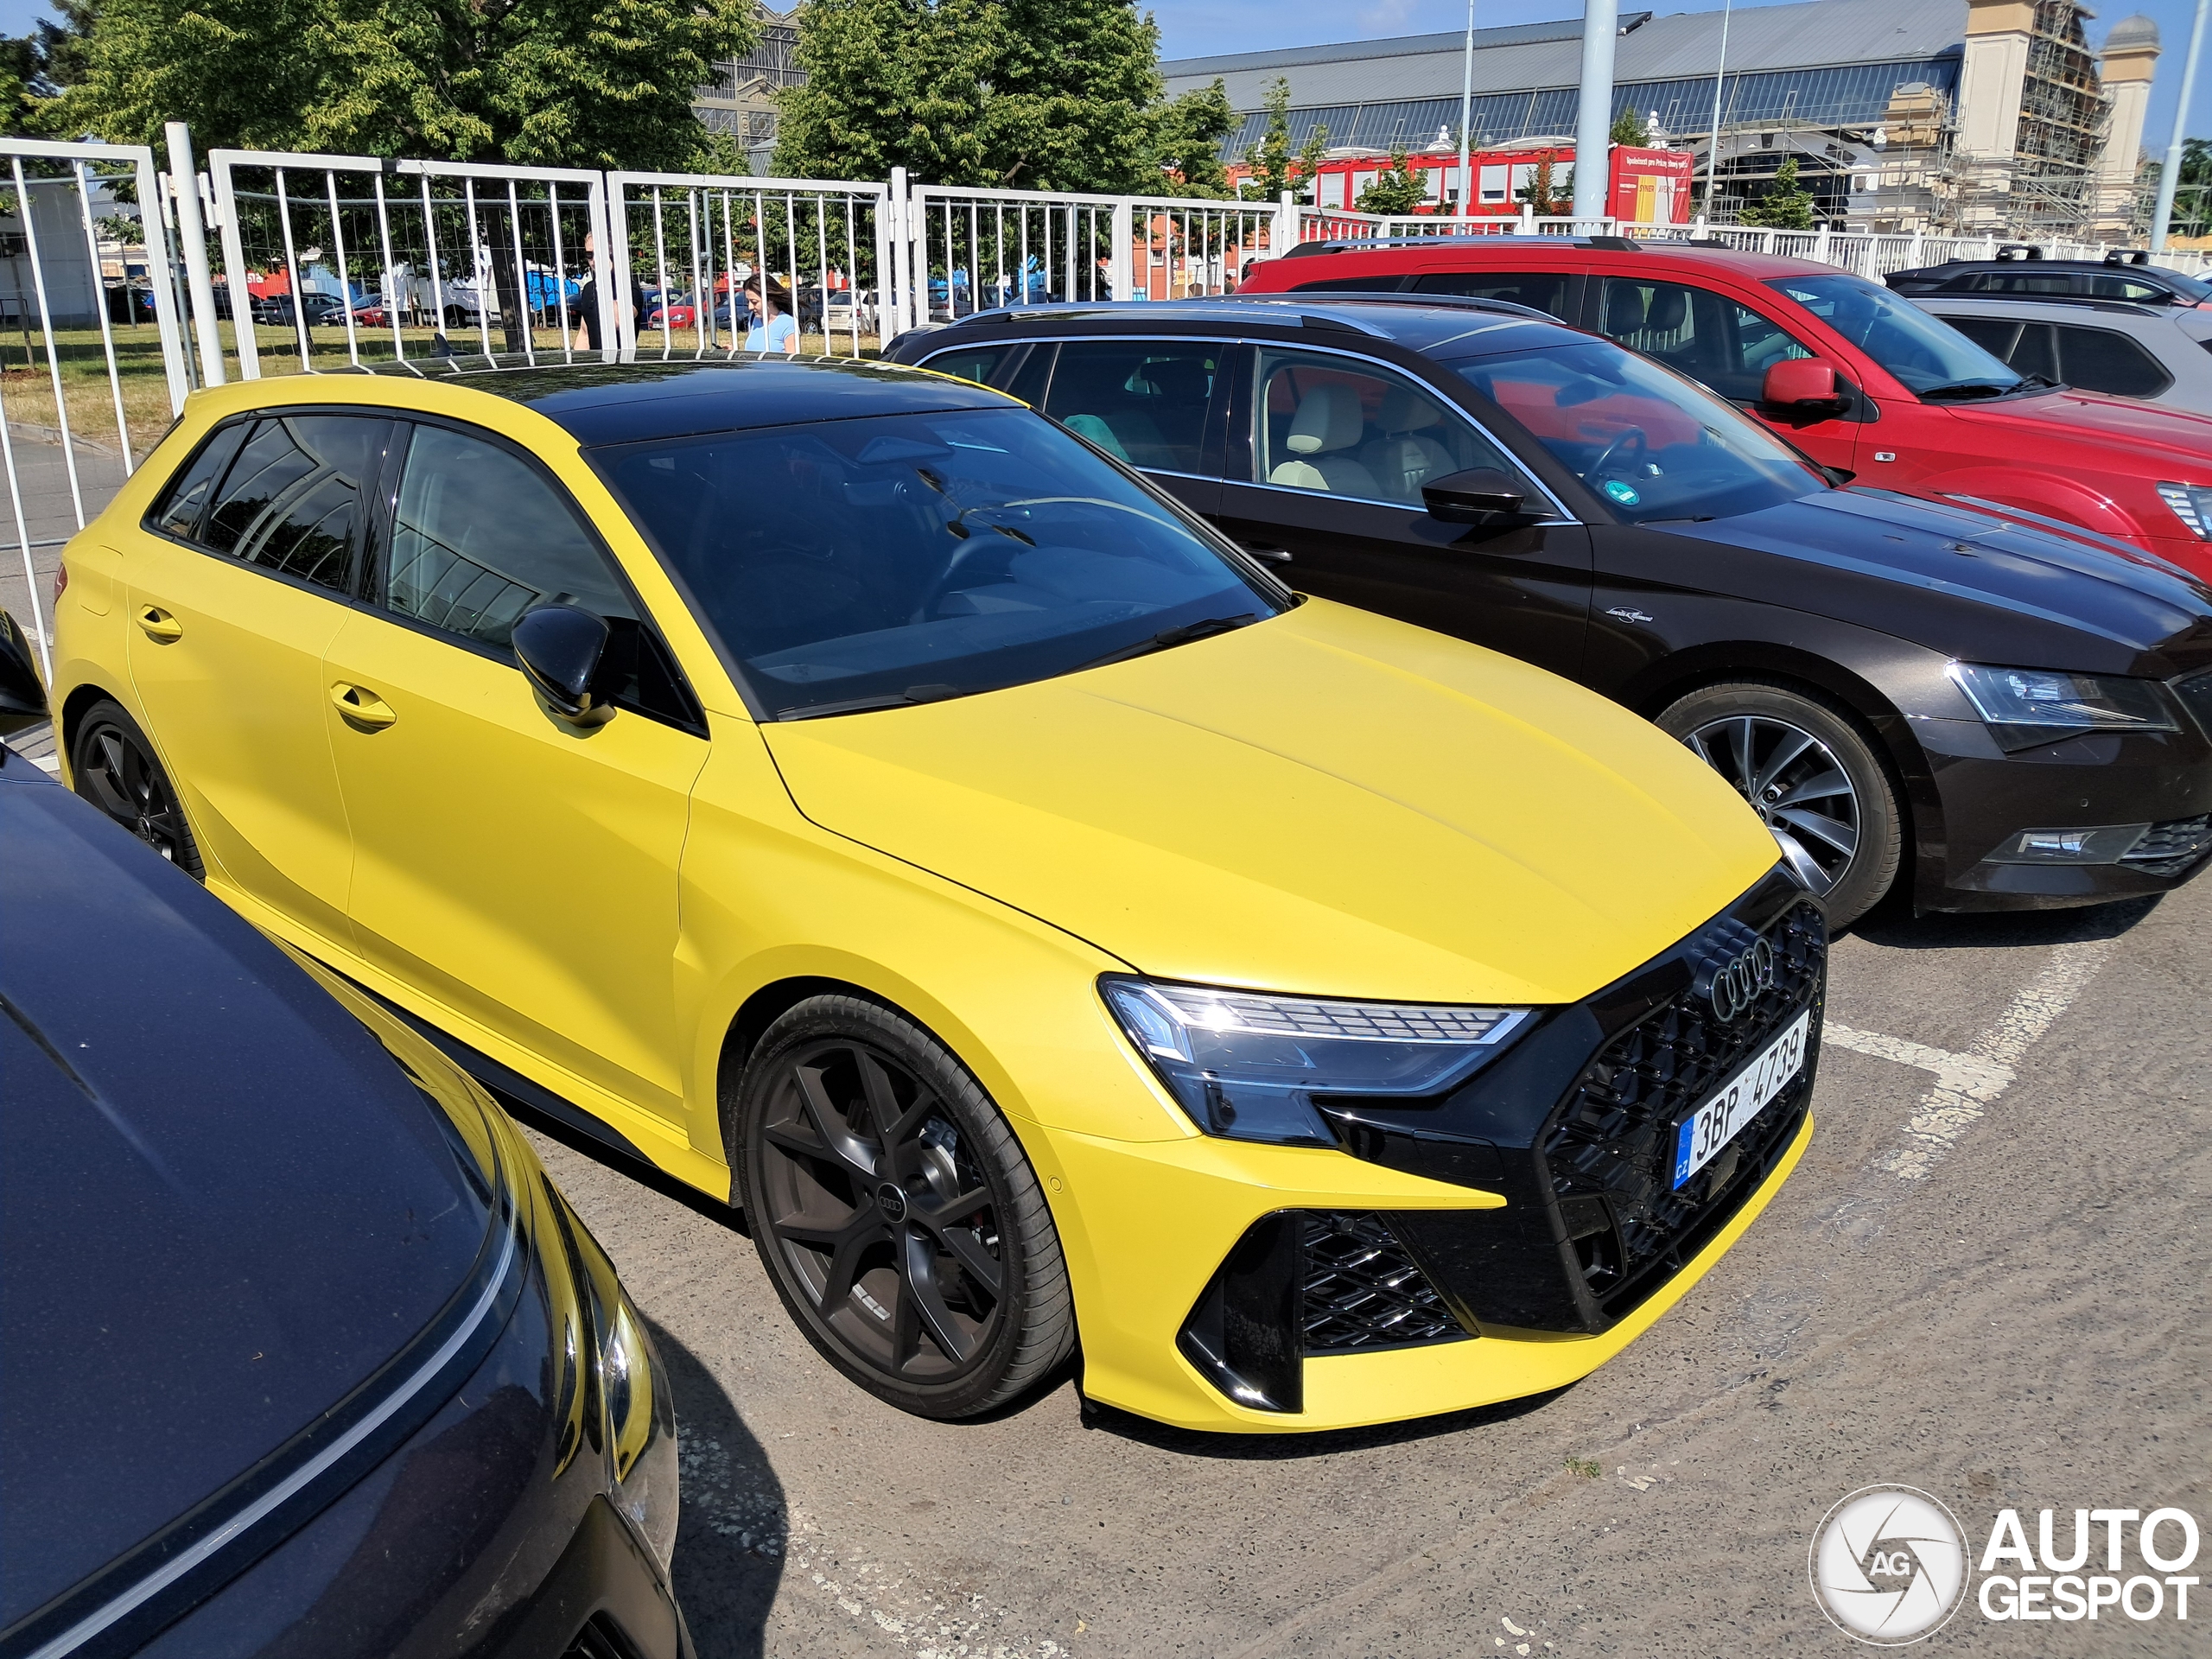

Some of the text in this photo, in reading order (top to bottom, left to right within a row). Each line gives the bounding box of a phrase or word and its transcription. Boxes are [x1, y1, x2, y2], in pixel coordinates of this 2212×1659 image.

[1696, 1027, 1800, 1161] 3BP 4739
[1675, 1159, 1688, 1179] CZ
